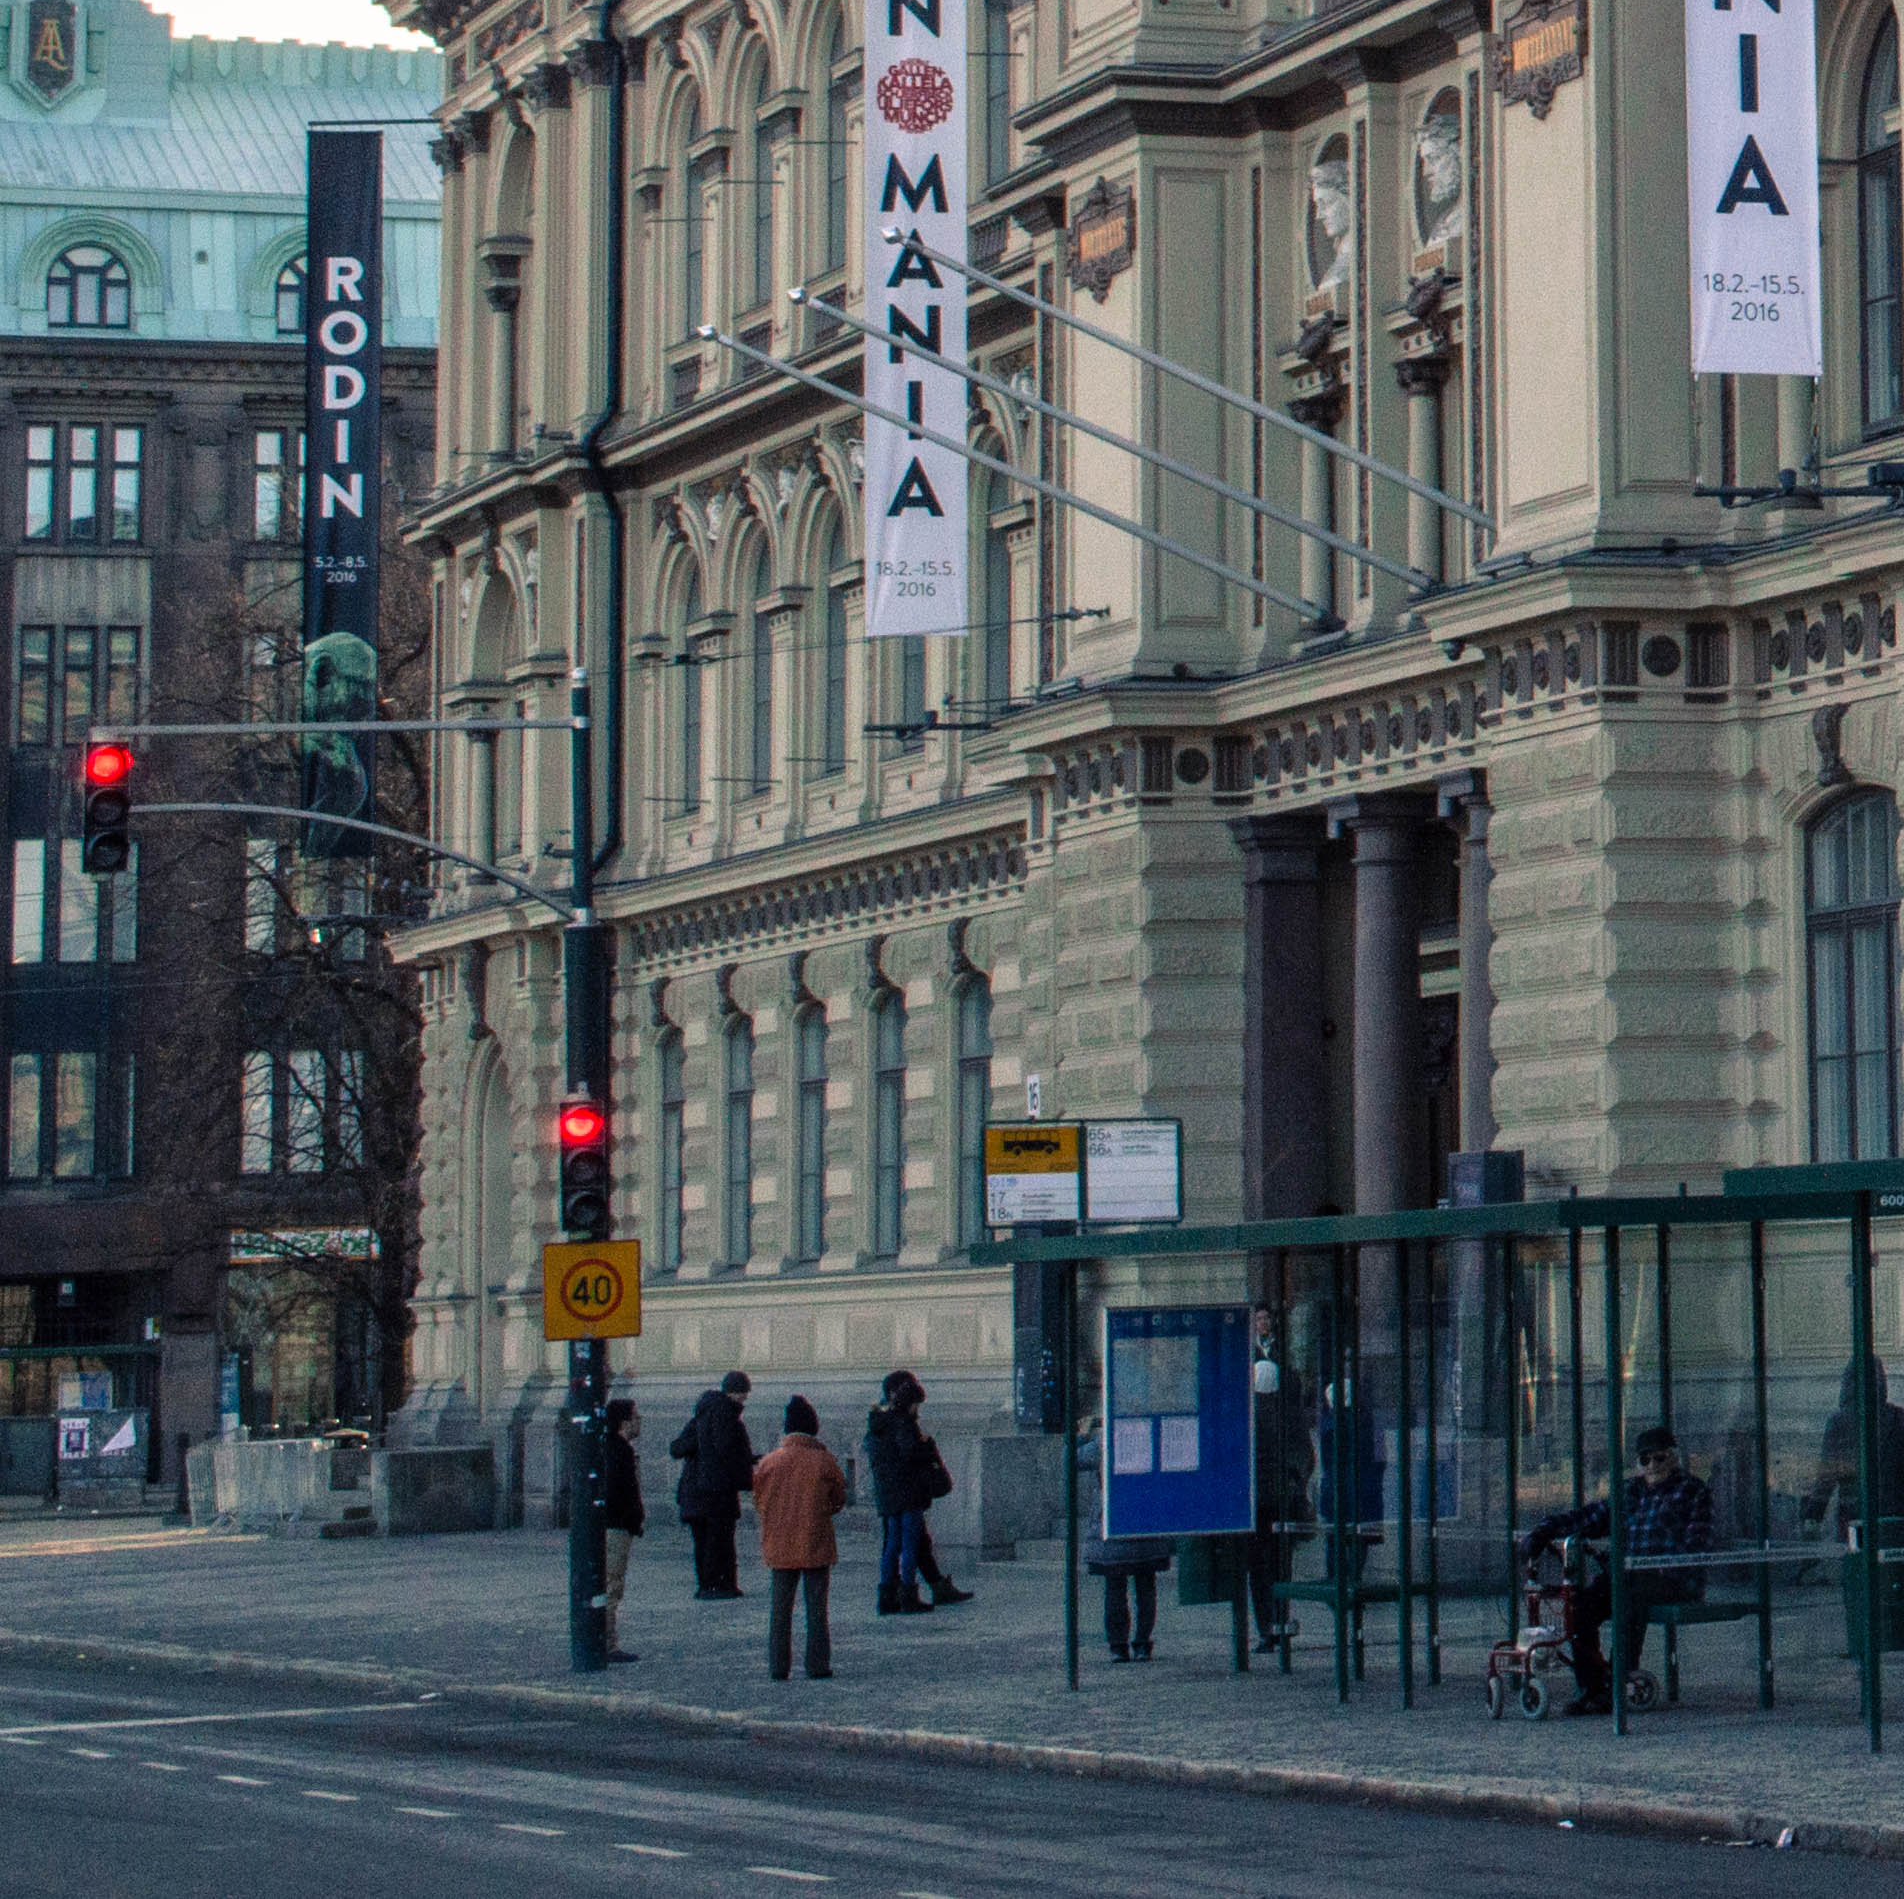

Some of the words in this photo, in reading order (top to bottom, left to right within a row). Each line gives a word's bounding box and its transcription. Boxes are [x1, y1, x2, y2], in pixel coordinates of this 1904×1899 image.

[1731, 301, 1780, 322] 2016
[880, 152, 949, 518] MANIA
[319, 255, 368, 519] RODIN
[326, 571, 357, 583] 2016
[897, 581, 937, 597] 2016
[572, 1275, 611, 1305] 40
